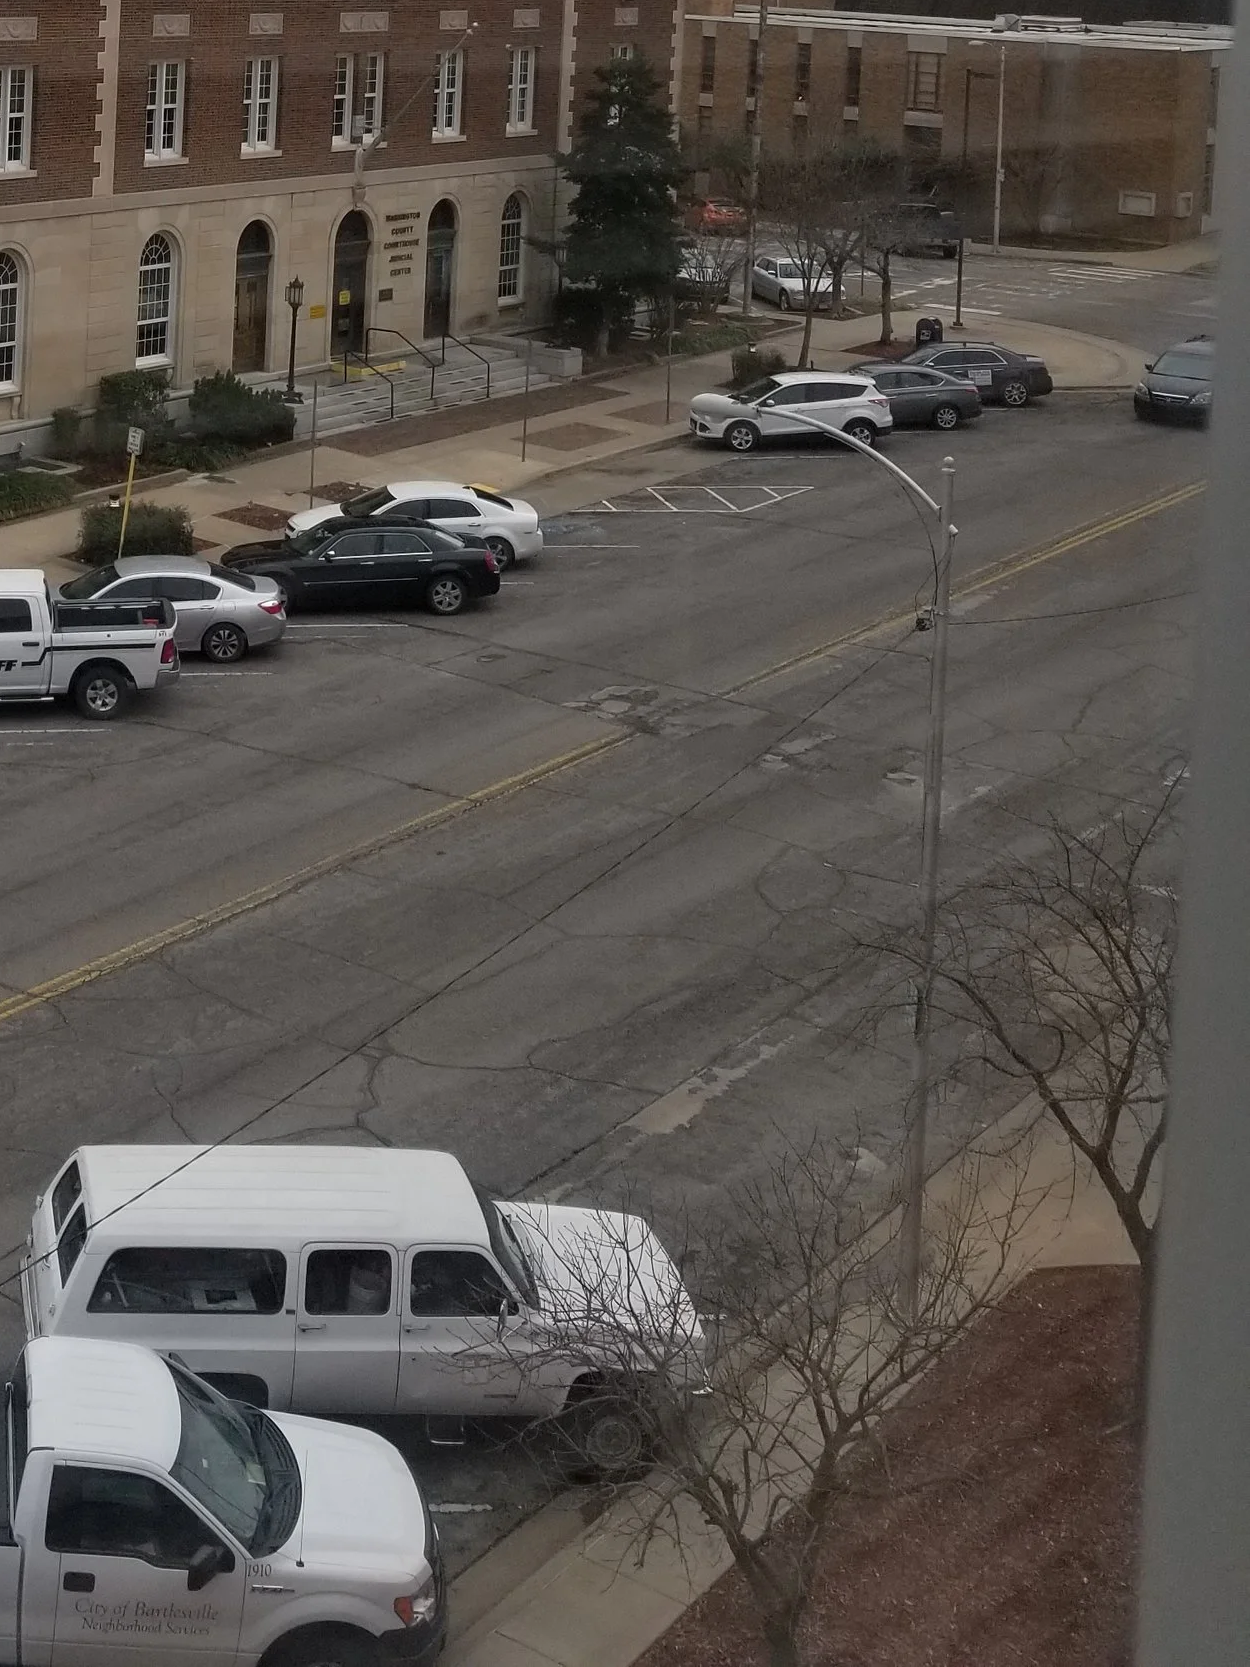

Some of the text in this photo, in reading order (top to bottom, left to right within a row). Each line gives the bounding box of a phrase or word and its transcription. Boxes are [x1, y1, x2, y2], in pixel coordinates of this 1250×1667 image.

[247, 1564, 272, 1577] 1910
[75, 1598, 219, 1620] City of Bartlesville
[82, 1618, 210, 1635] Neighborhood Services
